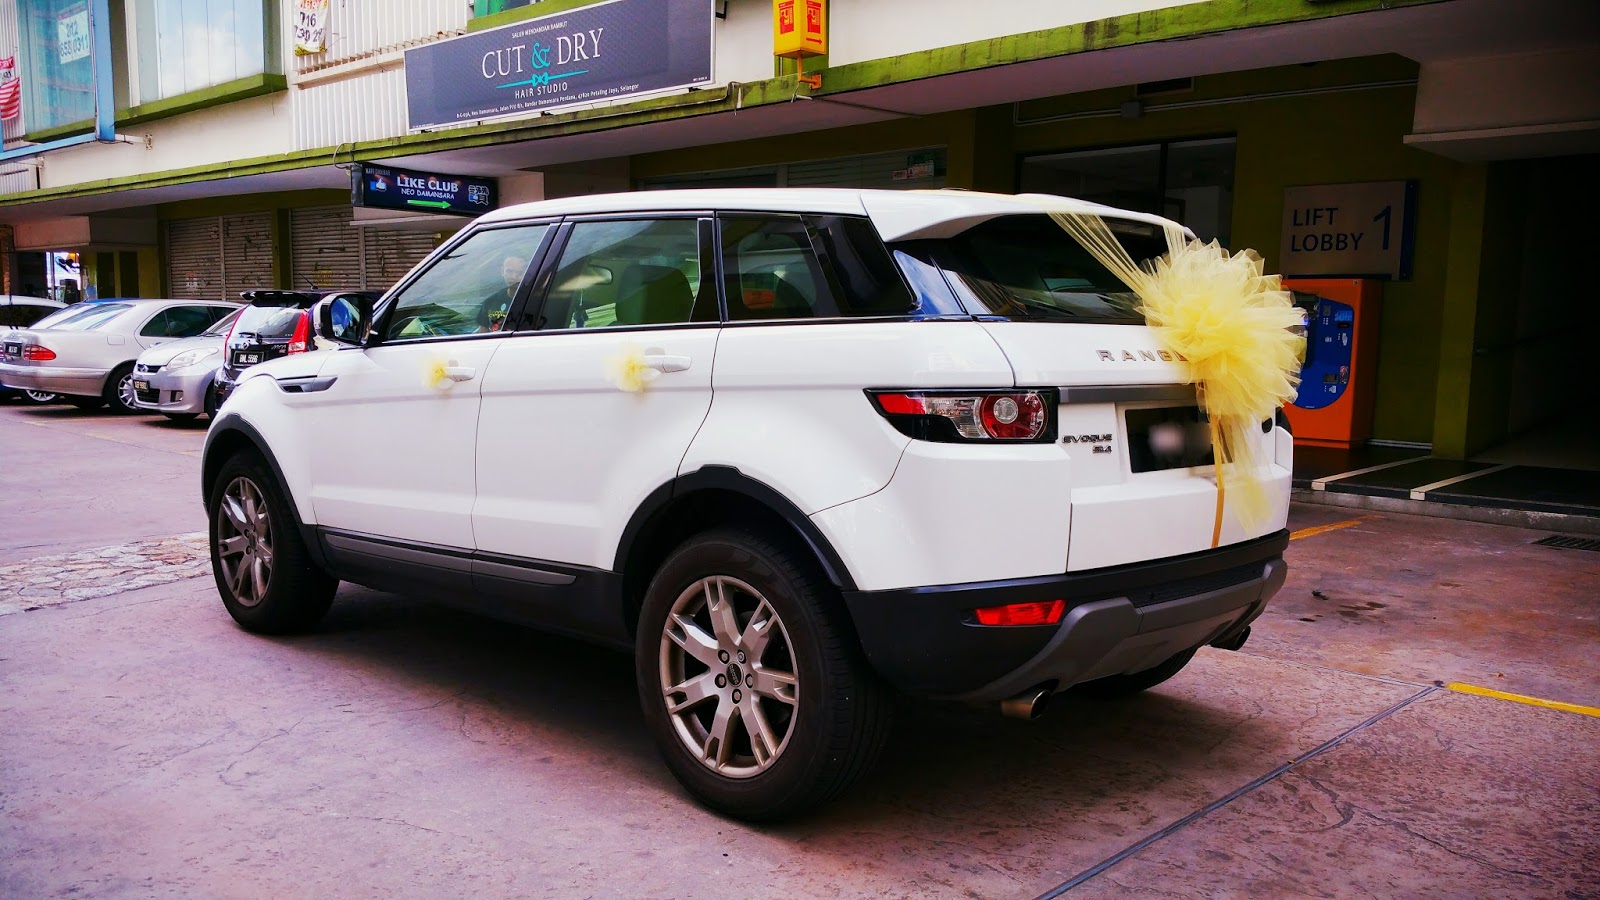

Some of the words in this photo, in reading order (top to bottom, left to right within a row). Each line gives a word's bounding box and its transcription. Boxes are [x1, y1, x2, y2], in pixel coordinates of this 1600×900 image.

[482, 45, 526, 79] CUT
[531, 42, 551, 69] &
[556, 27, 604, 65] DRY
[514, 87, 535, 99] HAIR
[537, 81, 568, 96] STUDIO
[590, 88, 608, 97] Petaling
[620, 83, 640, 92] Selangor
[396, 176, 426, 190] LIKE
[427, 180, 459, 193] CLUB
[401, 188, 415, 196] NEO
[417, 190, 455, 200] DAMANSARA
[1292, 207, 1339, 227] LIFT
[1373, 205, 1392, 250] 1
[1291, 232, 1365, 252] LOBBY
[1062, 434, 1112, 444] EVOQUE
